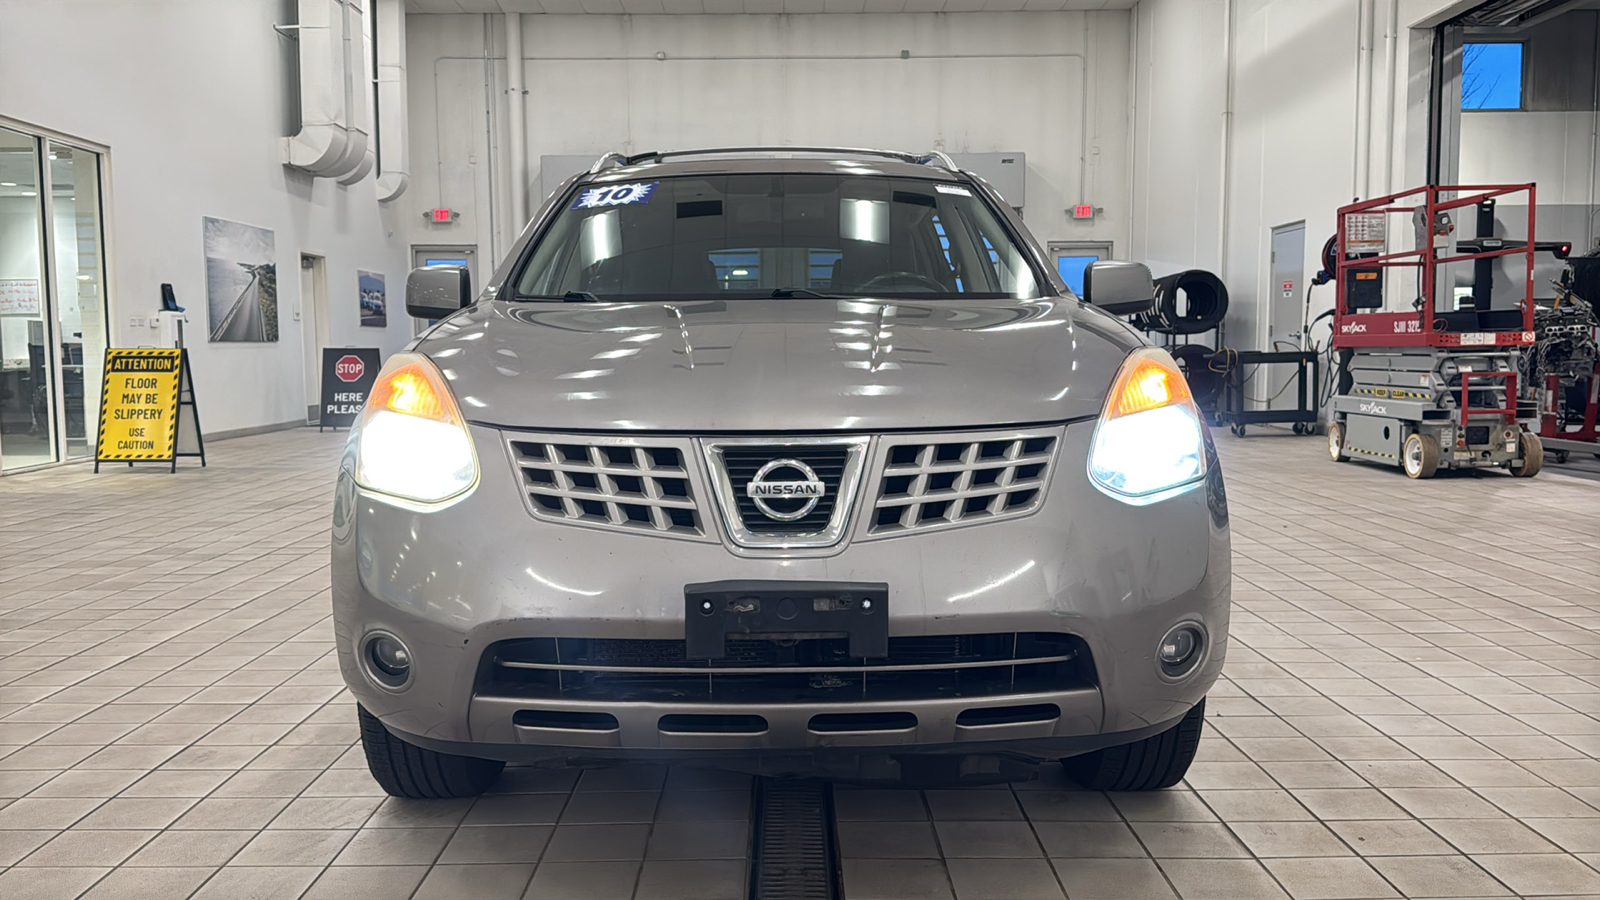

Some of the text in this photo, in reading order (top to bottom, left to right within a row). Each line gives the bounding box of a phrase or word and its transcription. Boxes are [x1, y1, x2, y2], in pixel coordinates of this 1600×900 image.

[597, 187, 634, 202] 10
[434, 209, 449, 221] EXIT
[1341, 321, 1367, 334] SKYJACK
[114, 358, 172, 370] ATTENTION
[337, 363, 362, 374] STOP
[125, 378, 158, 389] FLOOR
[122, 393, 158, 404] MAY BE
[334, 392, 363, 402] HERE
[327, 404, 362, 414] PLEAS
[1360, 402, 1387, 414] SKYJACK
[114, 408, 163, 420] SLIPPERY
[129, 427, 145, 437] USE
[117, 440, 154, 450] CAUTION
[755, 484, 817, 494] NISSAN
